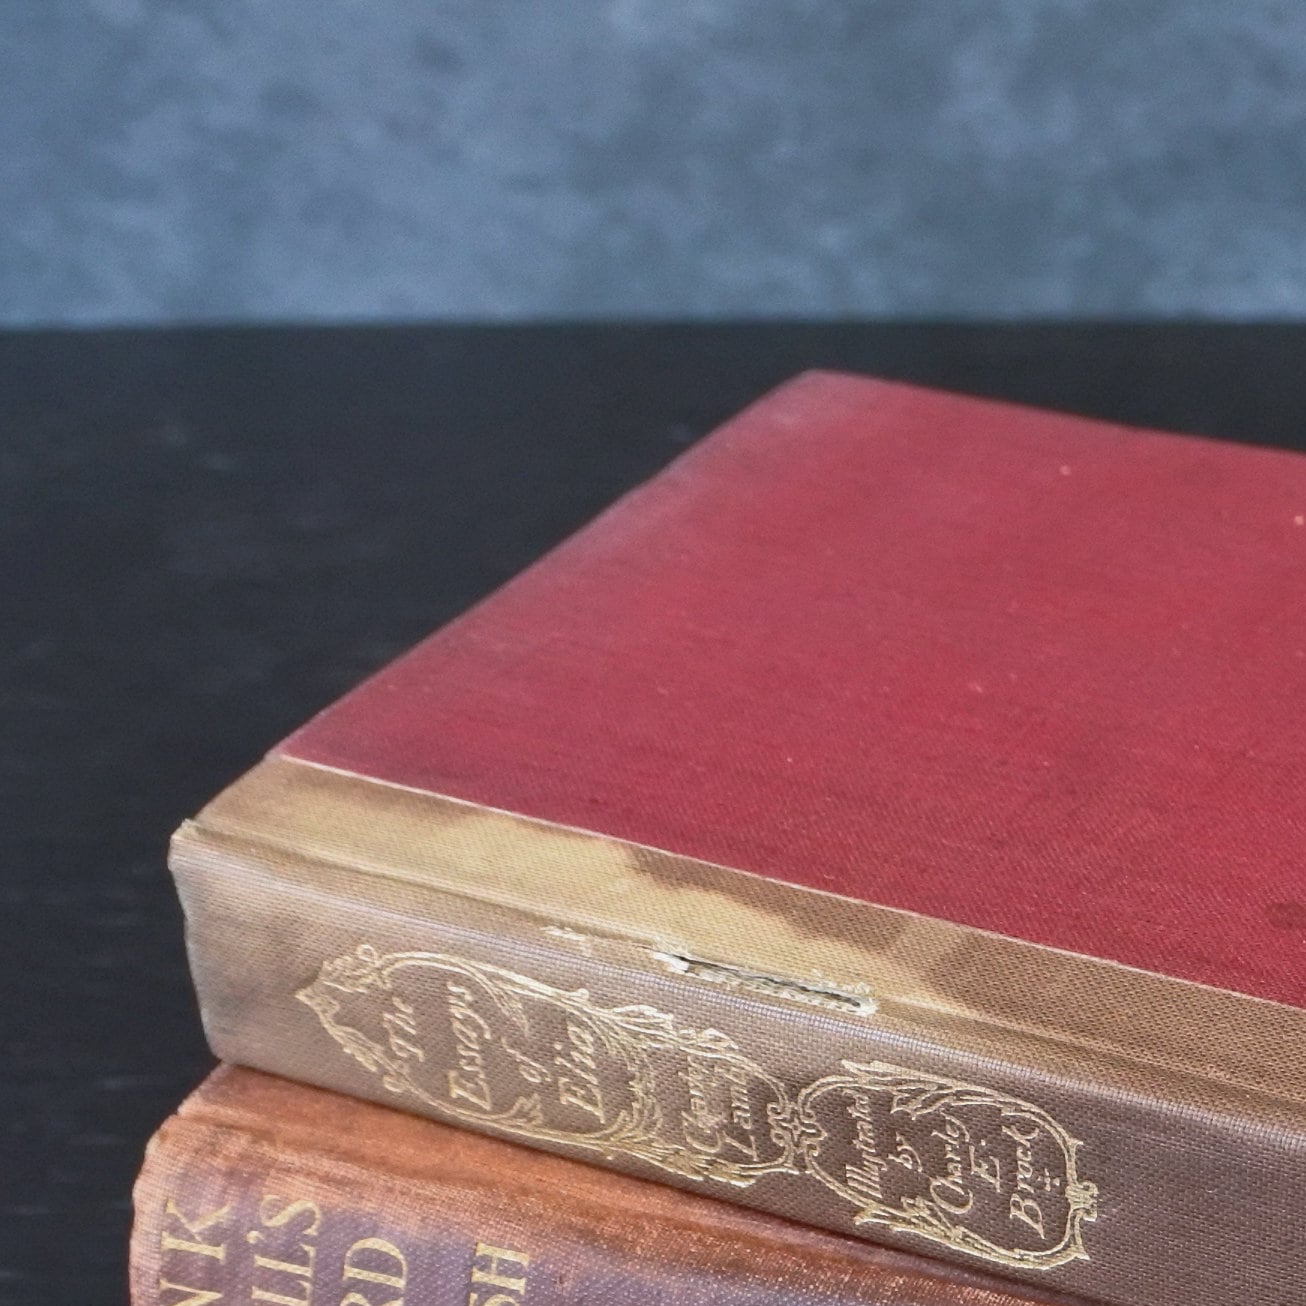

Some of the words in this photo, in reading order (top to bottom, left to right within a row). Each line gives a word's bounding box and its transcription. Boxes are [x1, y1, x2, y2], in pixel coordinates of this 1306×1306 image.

[382, 996, 425, 1063] The
[448, 981, 493, 1111] Essays
[502, 1036, 552, 1083] of
[557, 1017, 605, 1124] Elia
[844, 1089, 888, 1199] Illustrated
[888, 1131, 923, 1172] by
[929, 1108, 974, 1215] Charles
[1001, 1124, 1045, 1240] Brock
